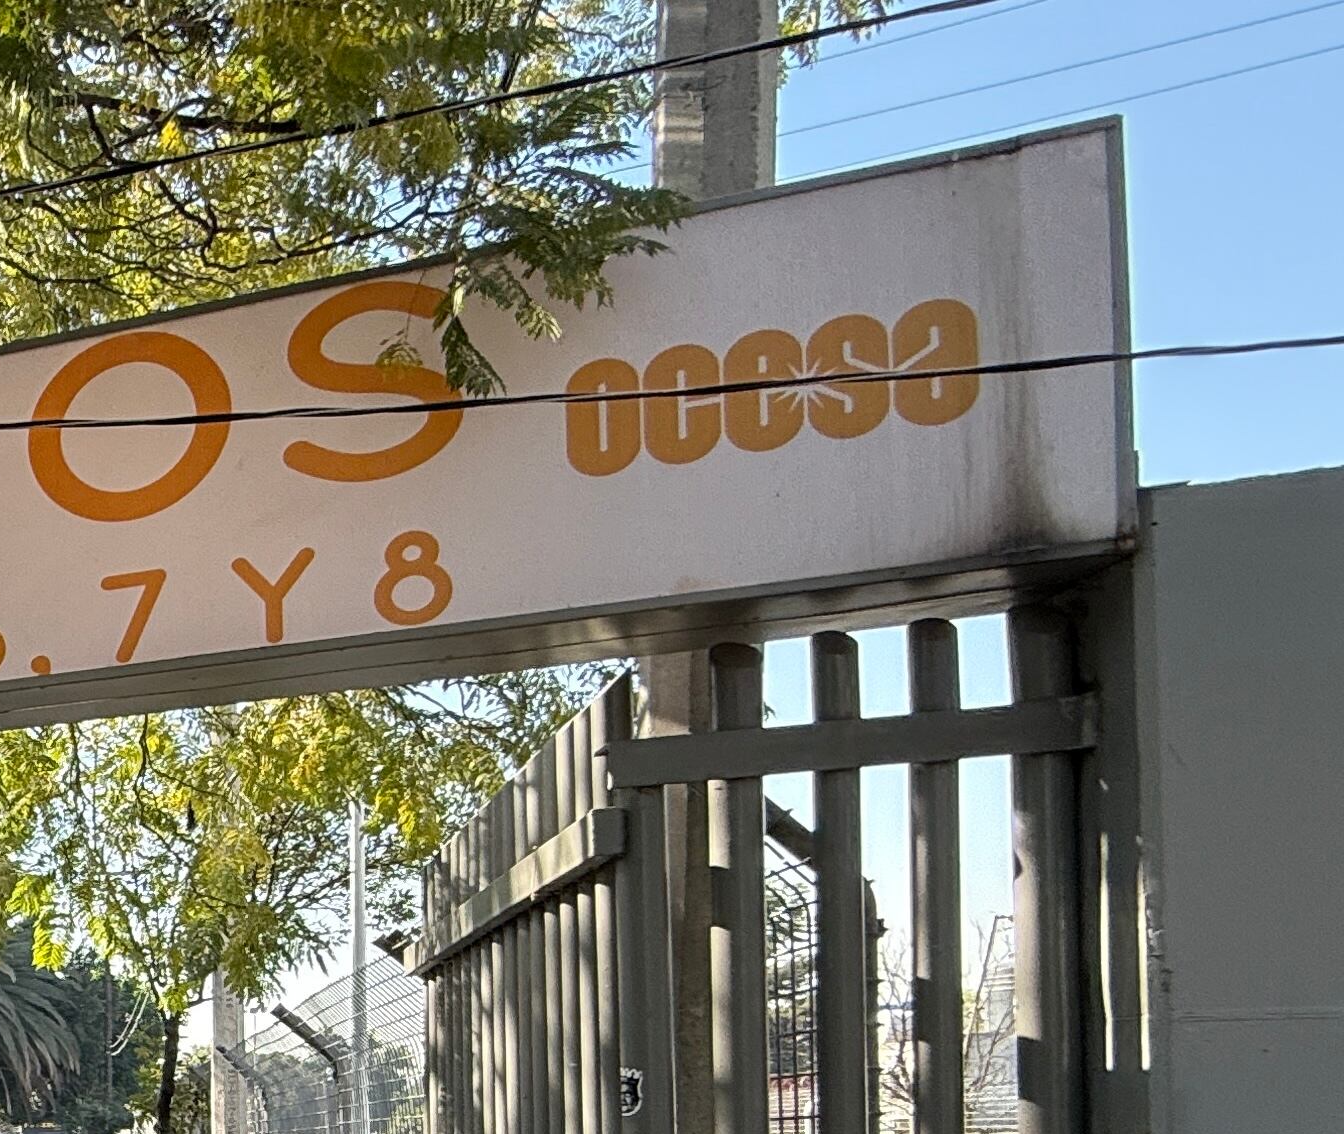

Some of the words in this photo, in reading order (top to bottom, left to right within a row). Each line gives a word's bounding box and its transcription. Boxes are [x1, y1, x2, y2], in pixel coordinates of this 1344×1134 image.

[100, 568, 167, 664] 7
[231, 547, 315, 643] Y
[373, 530, 453, 626] 8
